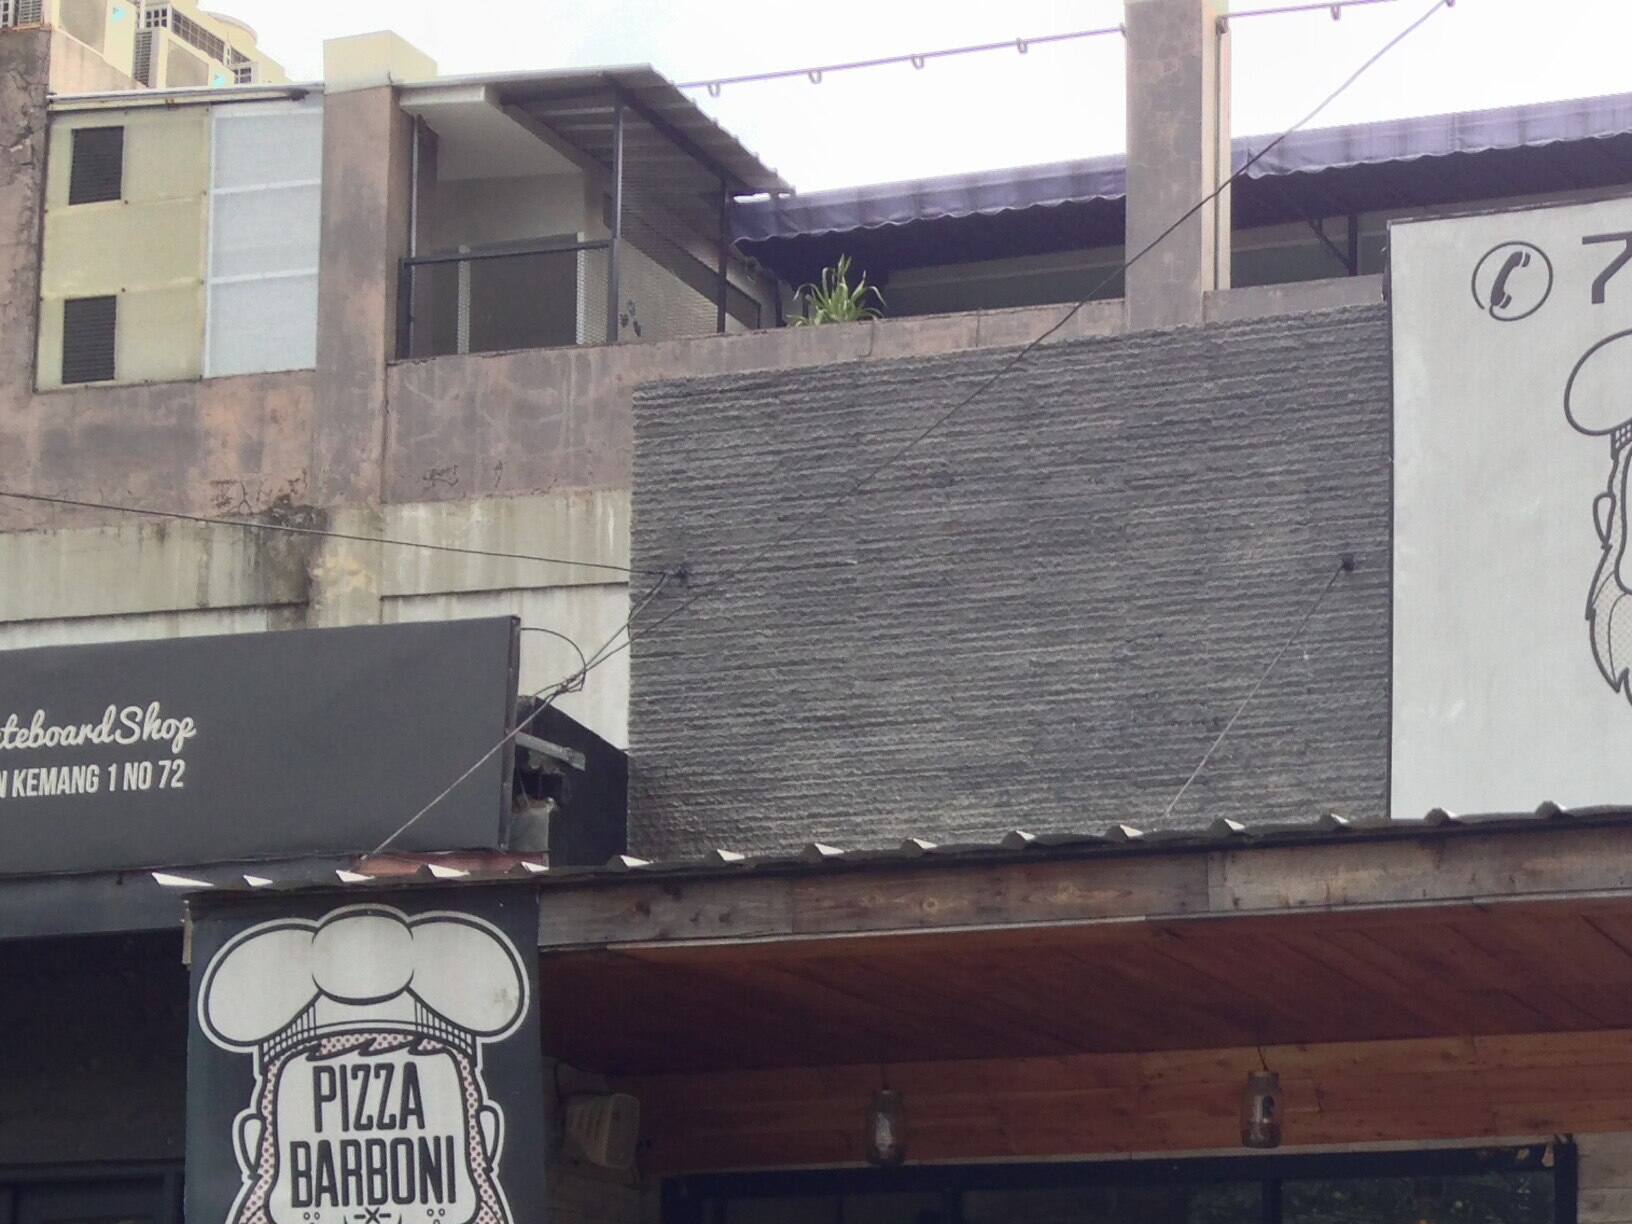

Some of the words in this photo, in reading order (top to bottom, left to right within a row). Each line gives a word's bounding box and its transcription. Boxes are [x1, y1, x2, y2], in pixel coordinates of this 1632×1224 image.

[11, 764, 100, 798] KEMANG
[107, 763, 118, 792] 1
[123, 761, 153, 791] NO
[158, 758, 187, 789] 72
[312, 1061, 426, 1134] PIZZA
[289, 1134, 457, 1209] BARBONI
